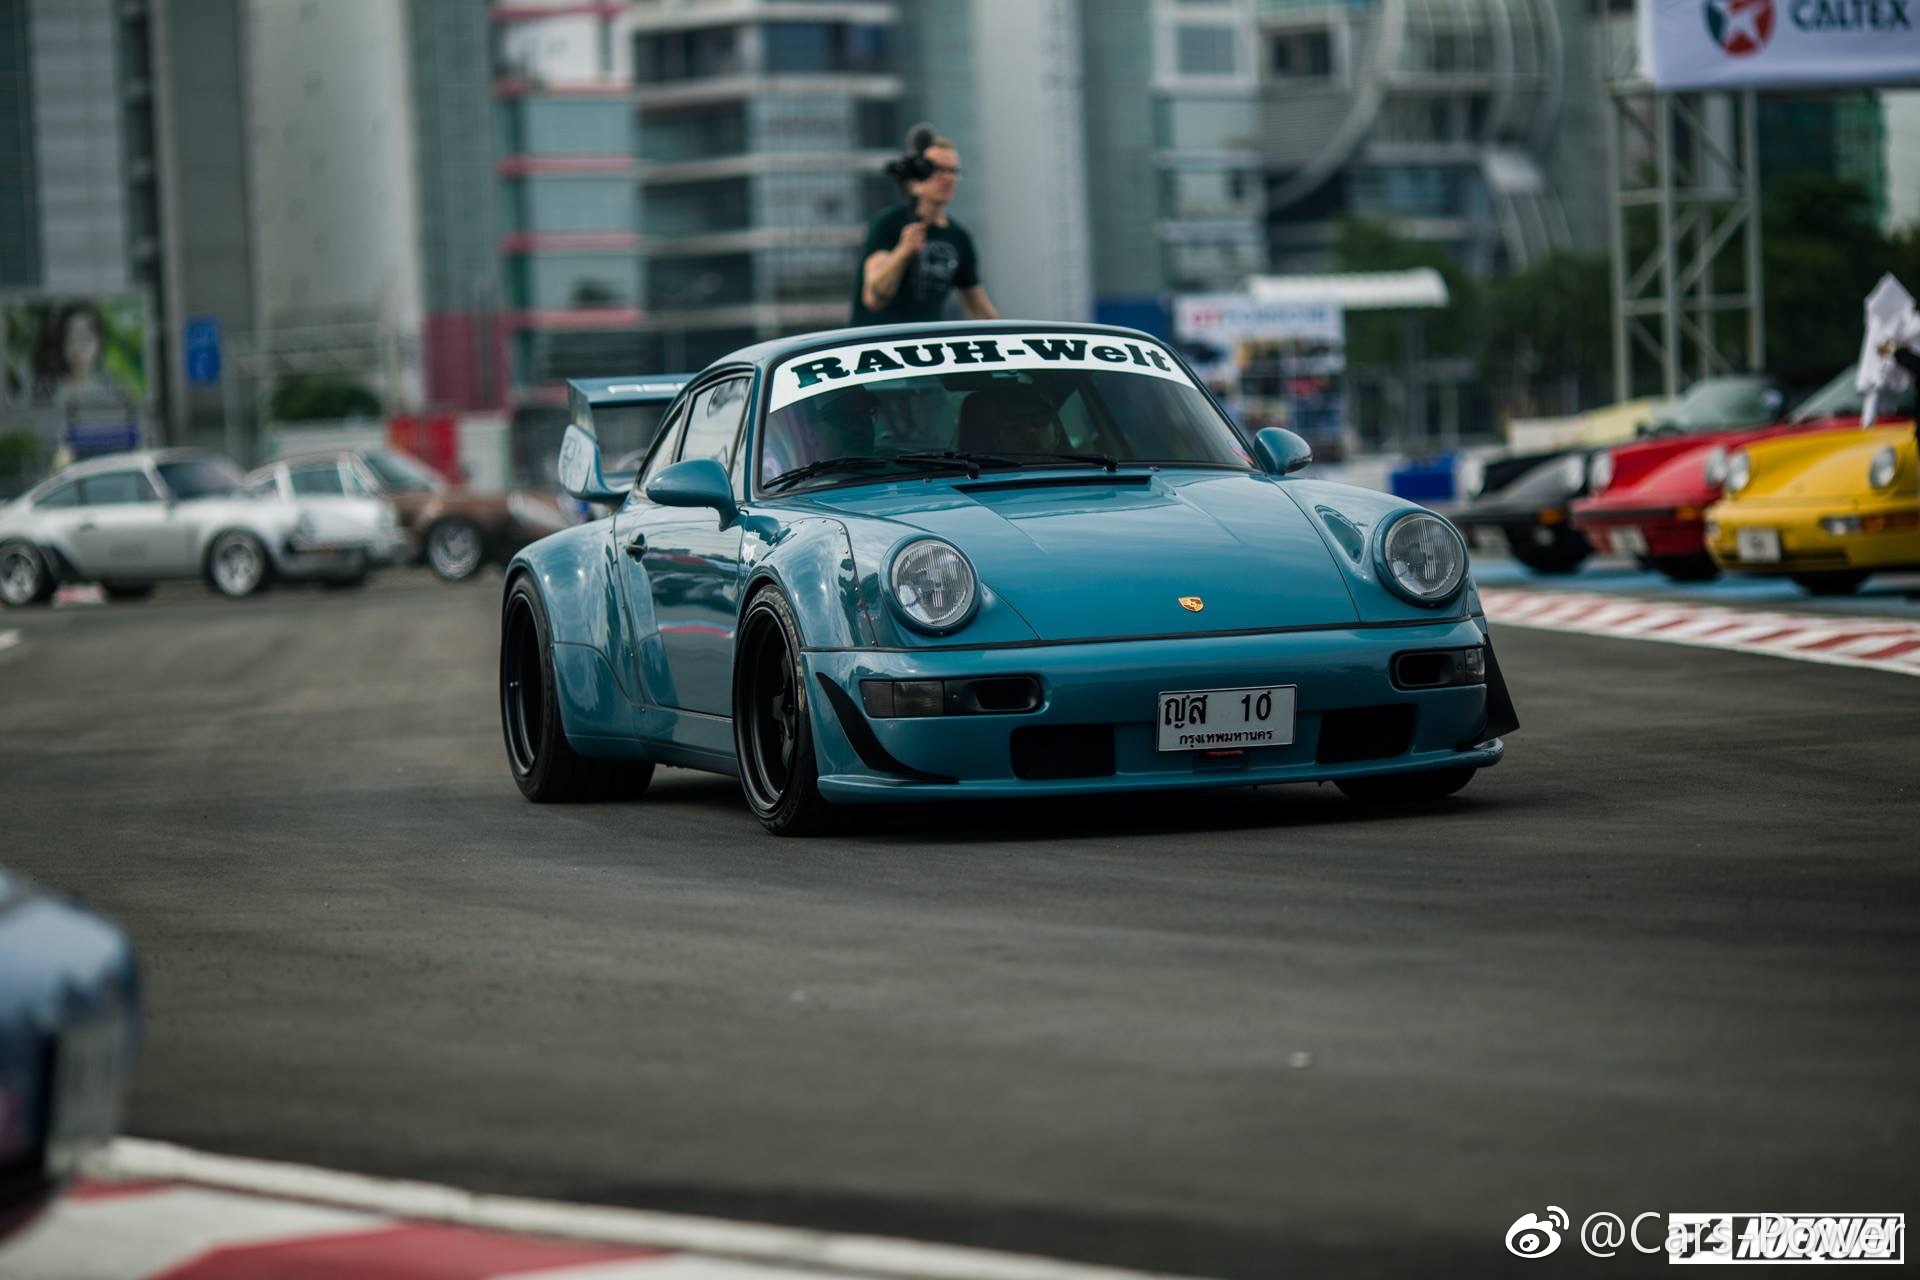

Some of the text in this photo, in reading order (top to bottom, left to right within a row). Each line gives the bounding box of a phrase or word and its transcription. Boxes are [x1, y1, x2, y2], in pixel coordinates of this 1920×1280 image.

[1791, 0, 1911, 31] CALTEX
[790, 338, 1172, 389] RAUH-Welt
[1164, 693, 1272, 728] ญส 10
[1179, 729, 1273, 748] กรุงเทพมหานคร
